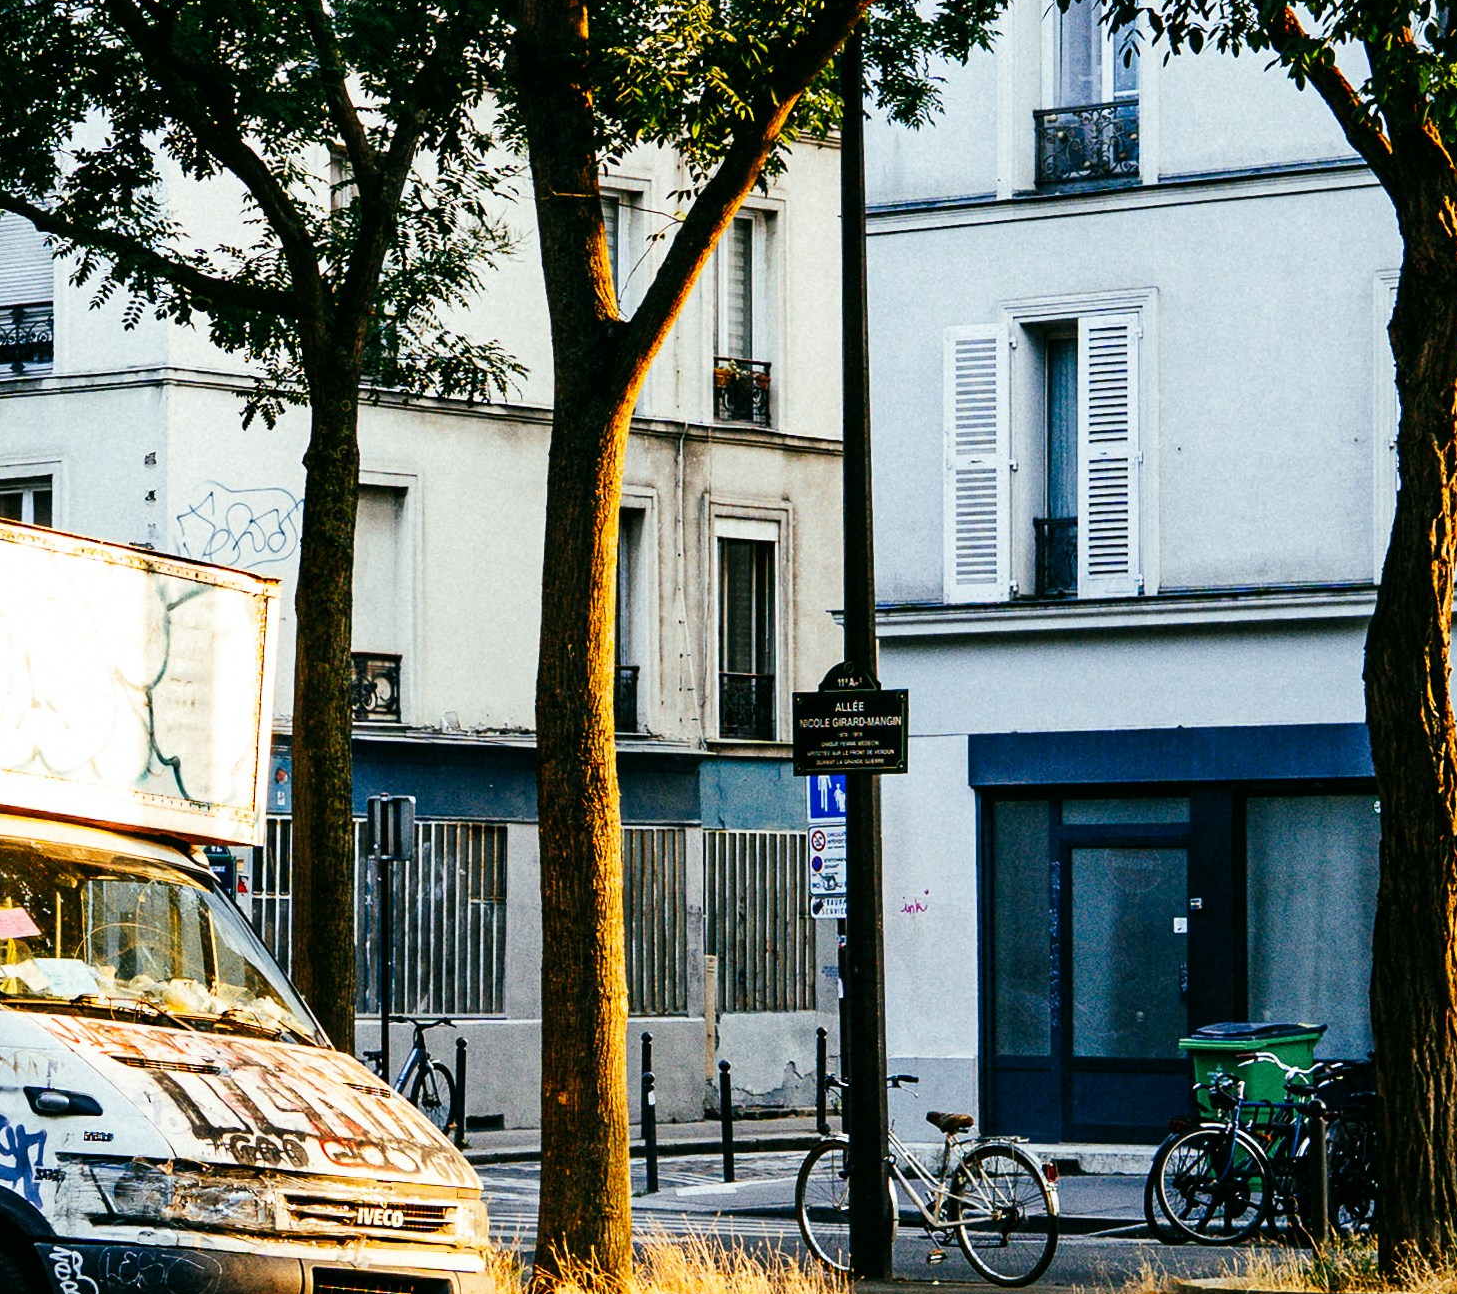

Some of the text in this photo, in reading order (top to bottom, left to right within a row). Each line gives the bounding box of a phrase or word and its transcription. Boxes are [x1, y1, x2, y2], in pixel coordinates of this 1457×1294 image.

[835, 700, 865, 712] ALLÉE
[799, 716, 902, 728] NICOLE GIRARD-MANGIN
[356, 1208, 404, 1228] IVECO
